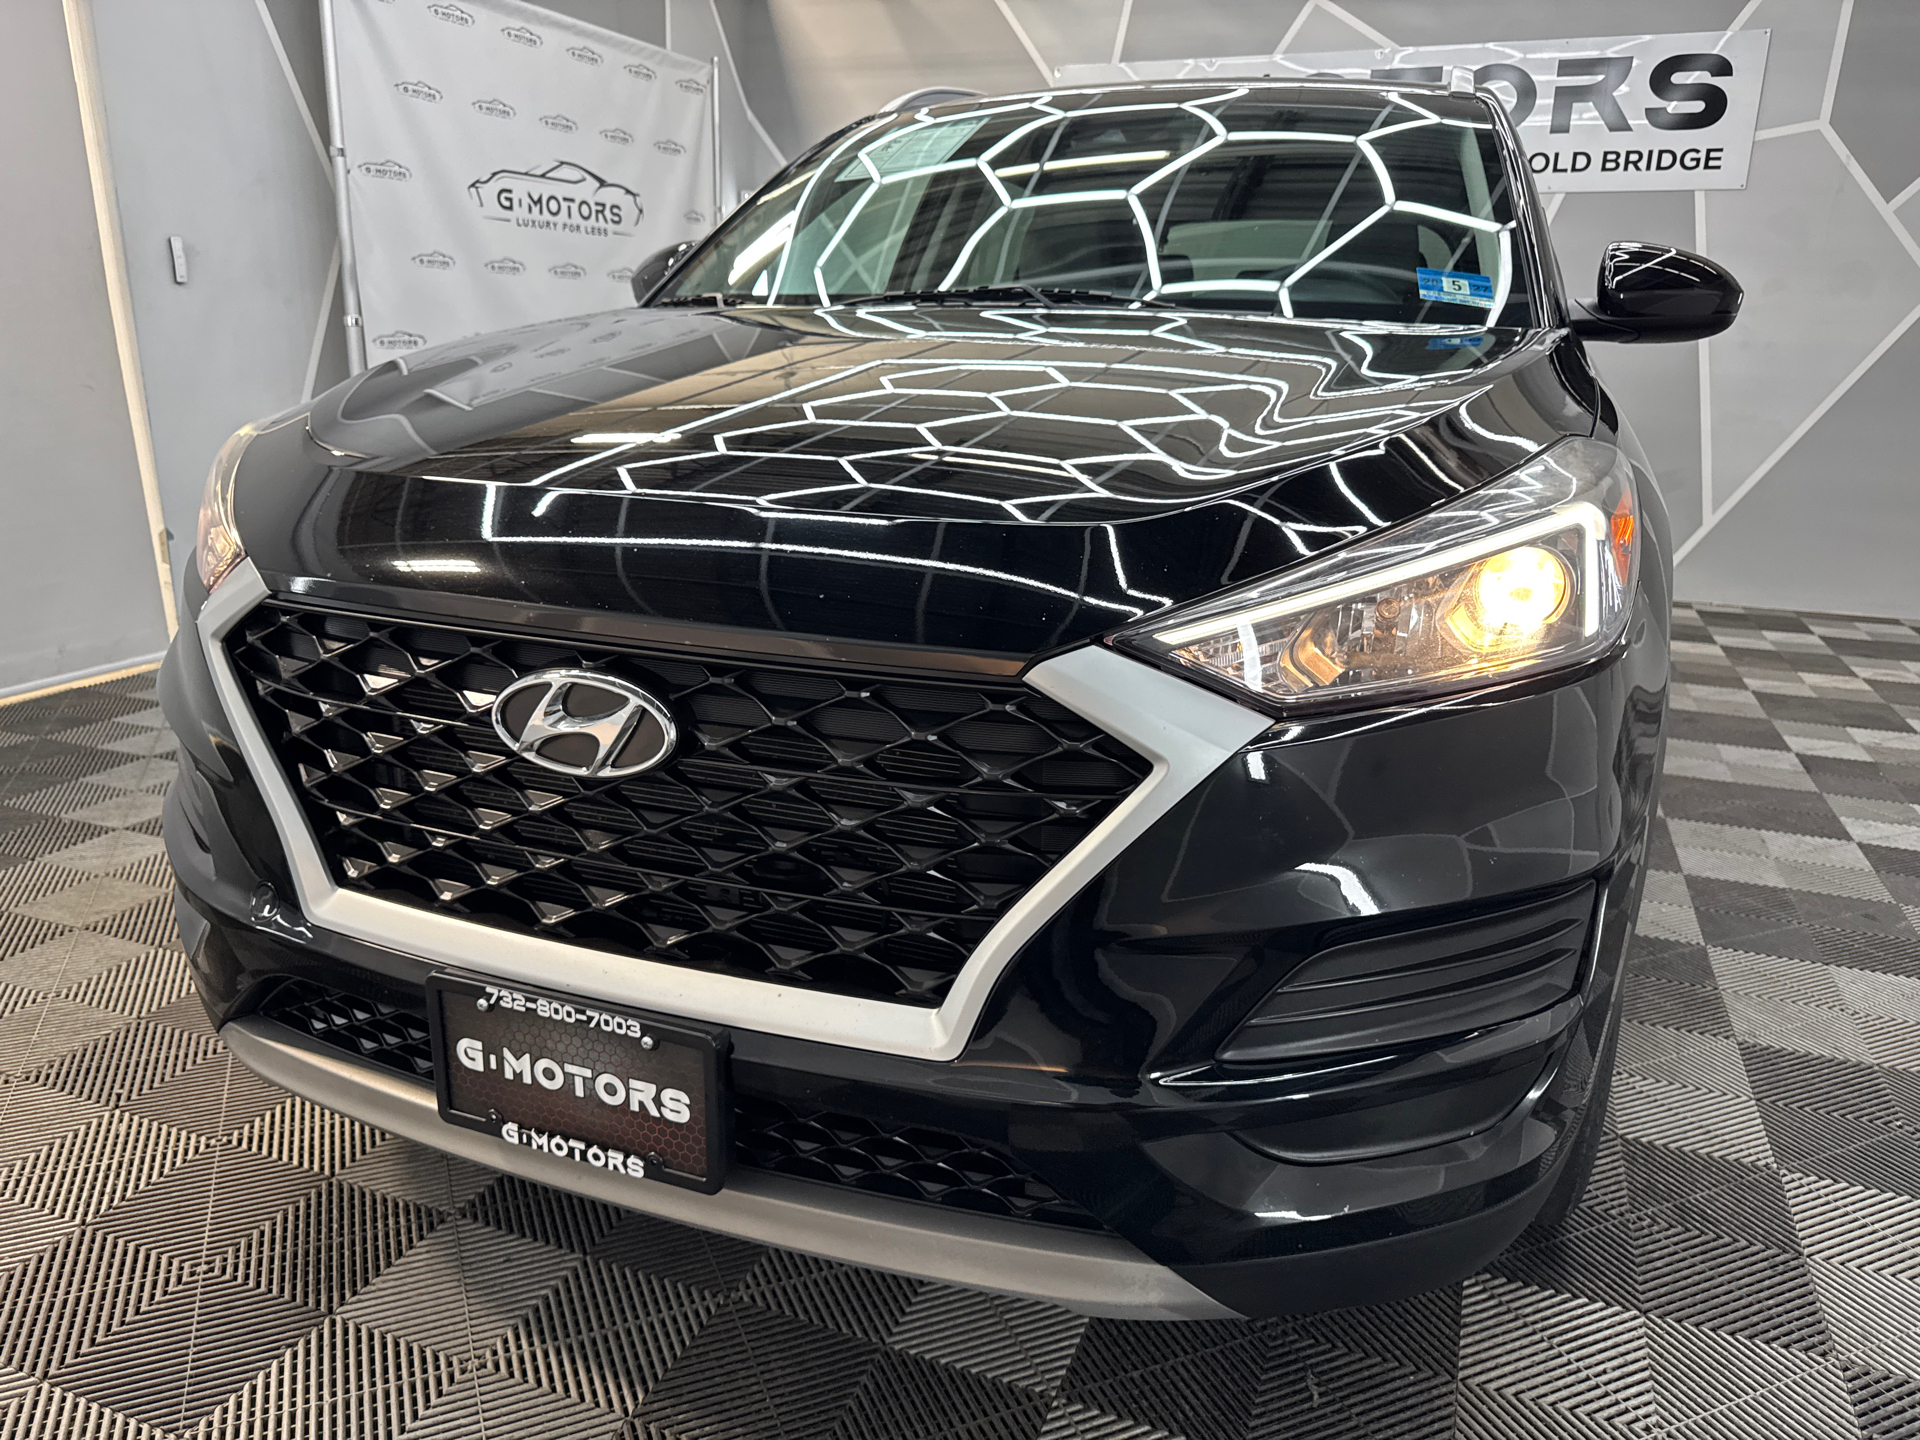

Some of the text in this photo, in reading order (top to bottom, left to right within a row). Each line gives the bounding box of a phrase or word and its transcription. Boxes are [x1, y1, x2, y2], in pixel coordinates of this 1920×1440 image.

[1528, 147, 1725, 174] OLD BRIDGE
[516, 217, 608, 237] LUXURY FOR LESS
[1452, 280, 1462, 291] 5
[1472, 284, 1489, 293] 27
[485, 986, 642, 1038] 732-800-7003
